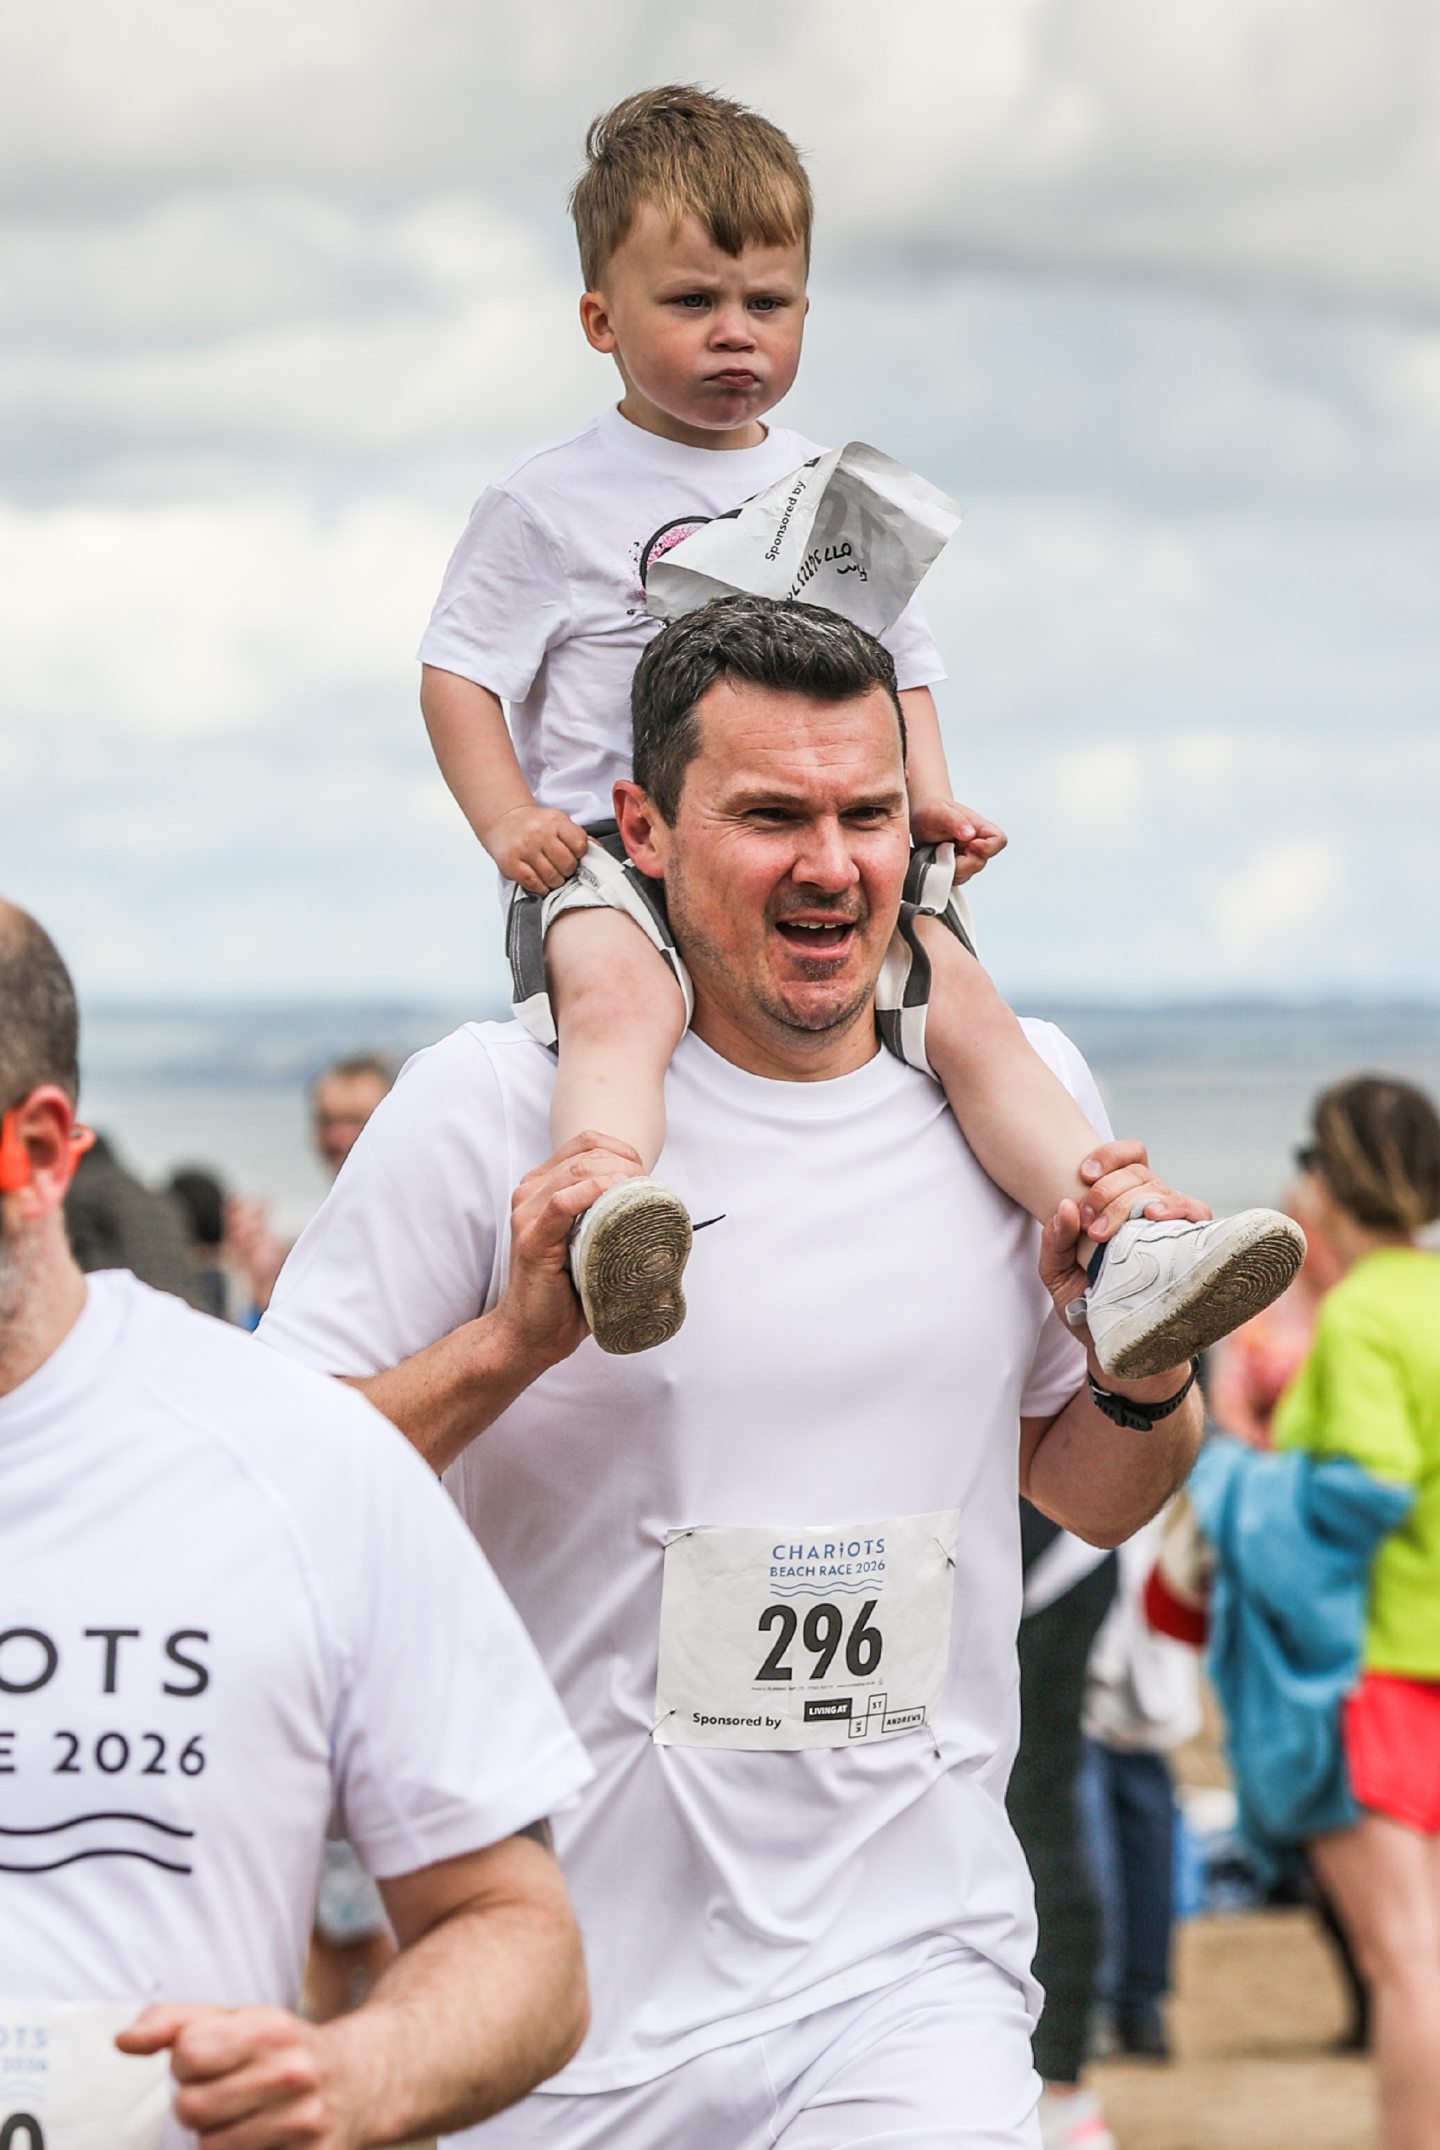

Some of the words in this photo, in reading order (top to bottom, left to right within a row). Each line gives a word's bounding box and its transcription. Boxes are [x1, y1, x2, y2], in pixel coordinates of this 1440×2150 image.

[764, 496, 798, 562] Sponsored
[792, 480, 807, 495] by
[769, 1565, 816, 1578] BEACH
[818, 1563, 853, 1577] RACE
[856, 1559, 886, 1574] 2026
[754, 1599, 883, 1681] 296
[808, 1705, 837, 1716] LIVING
[836, 1703, 849, 1714] AT
[871, 1700, 883, 1710] ST
[692, 1712, 762, 1727] Sponsored
[765, 1715, 782, 1730] by
[885, 1713, 922, 1726] ANDREWS
[53, 1730, 206, 1777] 2026
